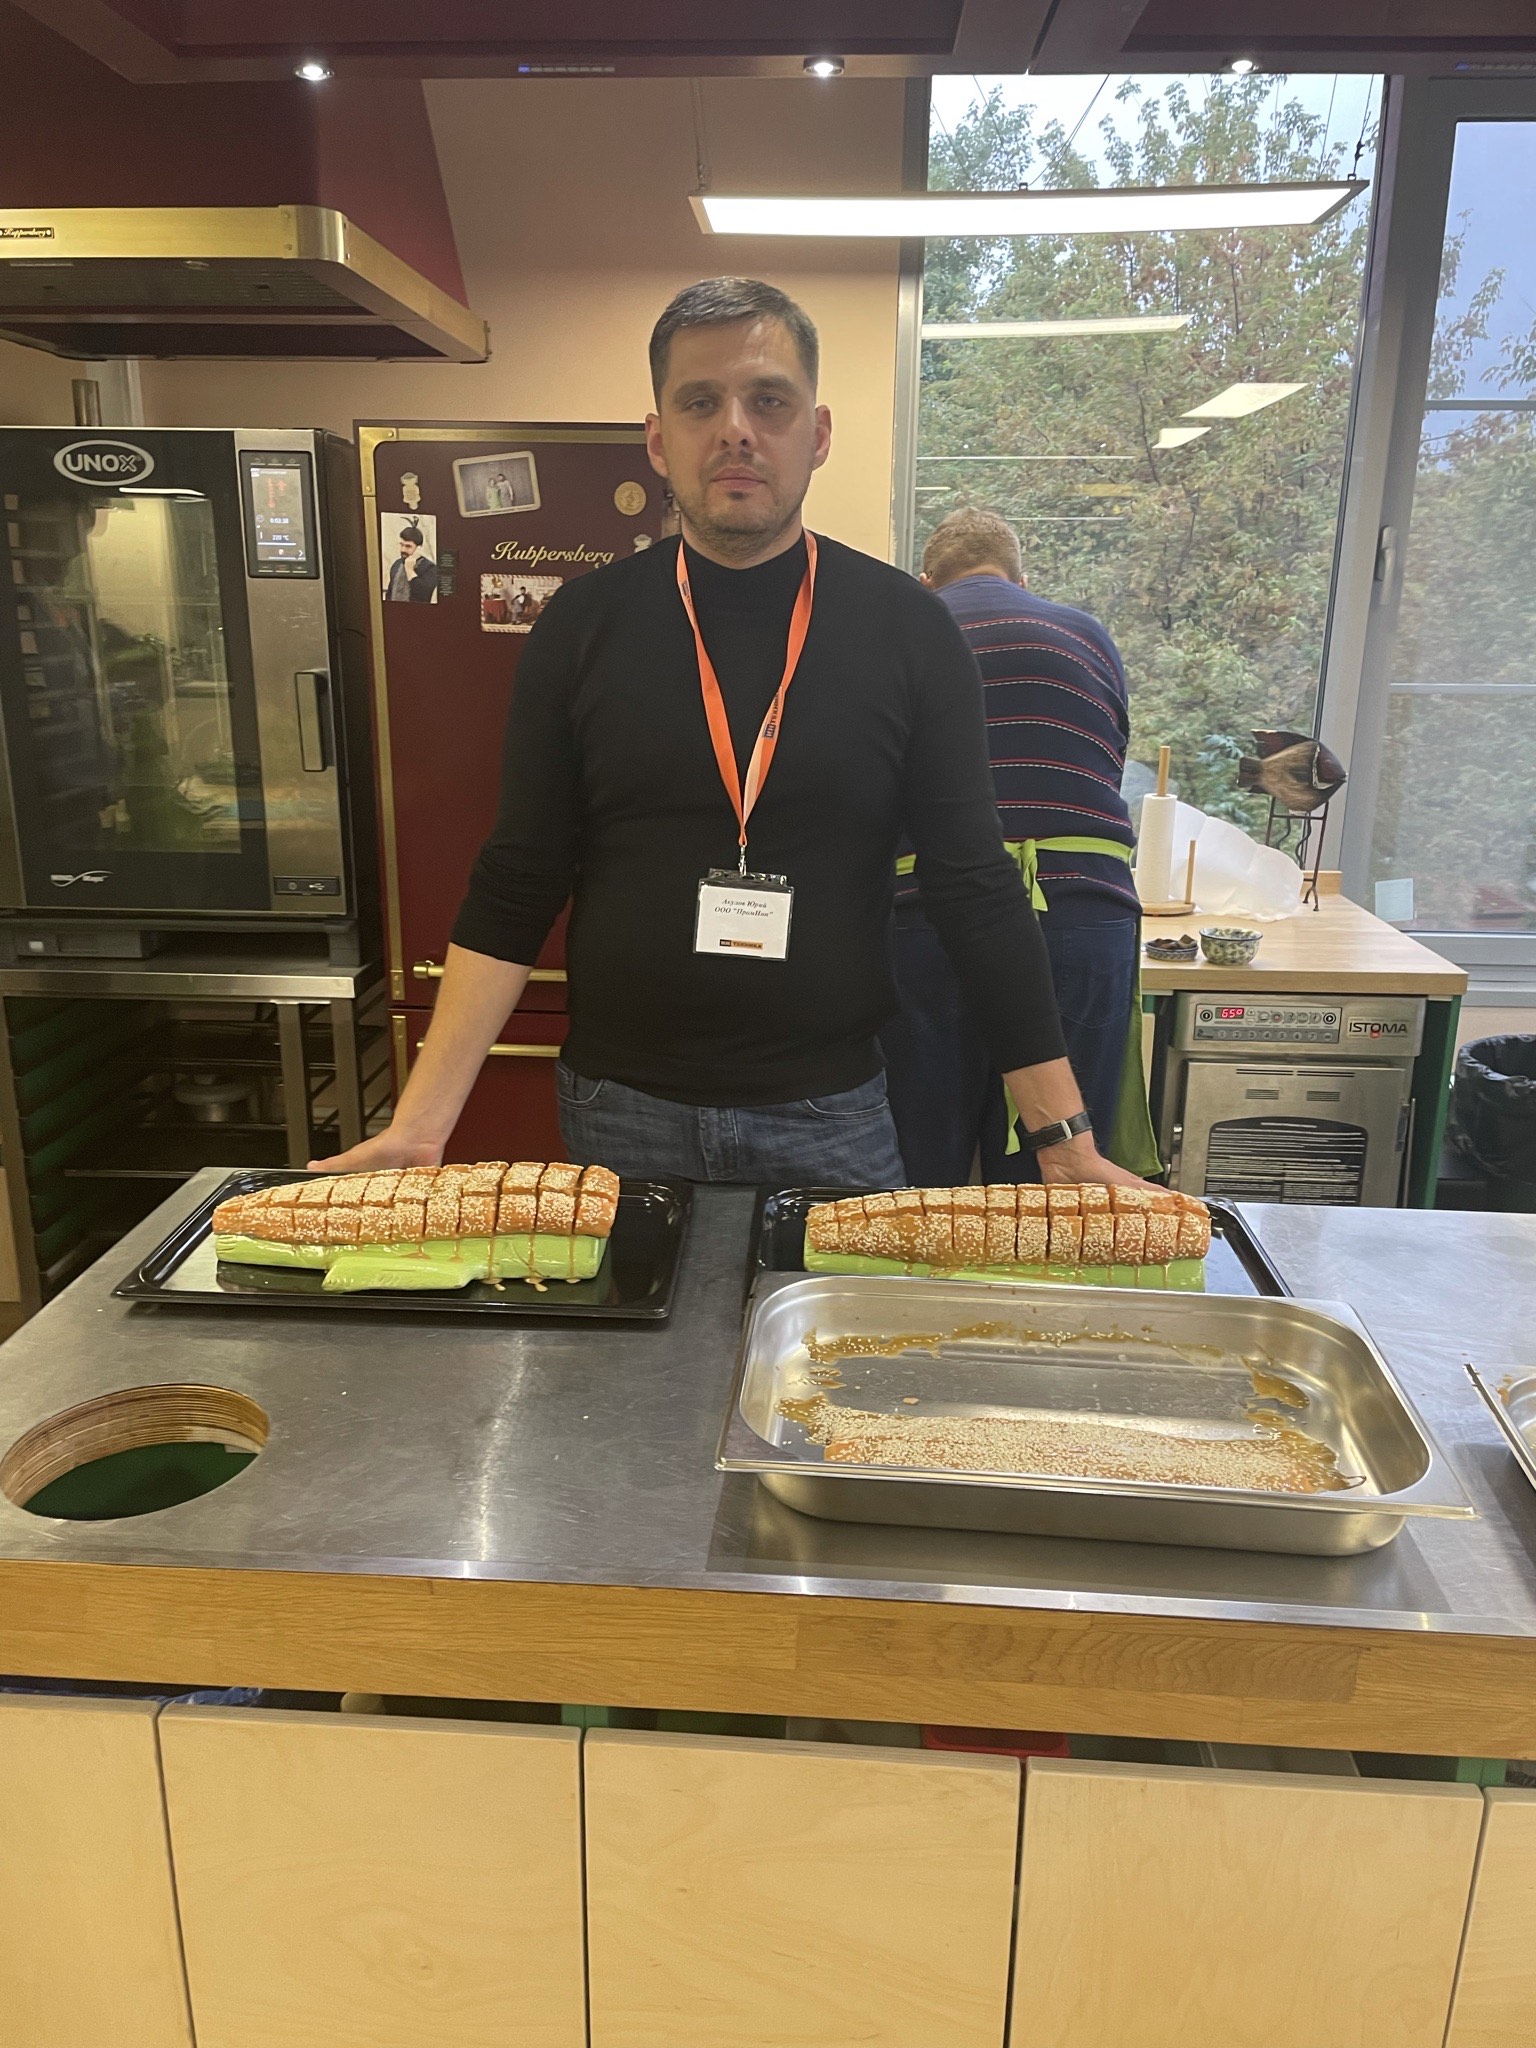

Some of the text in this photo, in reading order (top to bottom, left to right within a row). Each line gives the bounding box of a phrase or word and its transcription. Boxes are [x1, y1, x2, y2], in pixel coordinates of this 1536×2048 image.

[65, 453, 138, 473] UNOX
[747, 900, 768, 909] Юрий
[714, 906, 731, 914] ООО
[1348, 1022, 1409, 1034] ISTOMA
